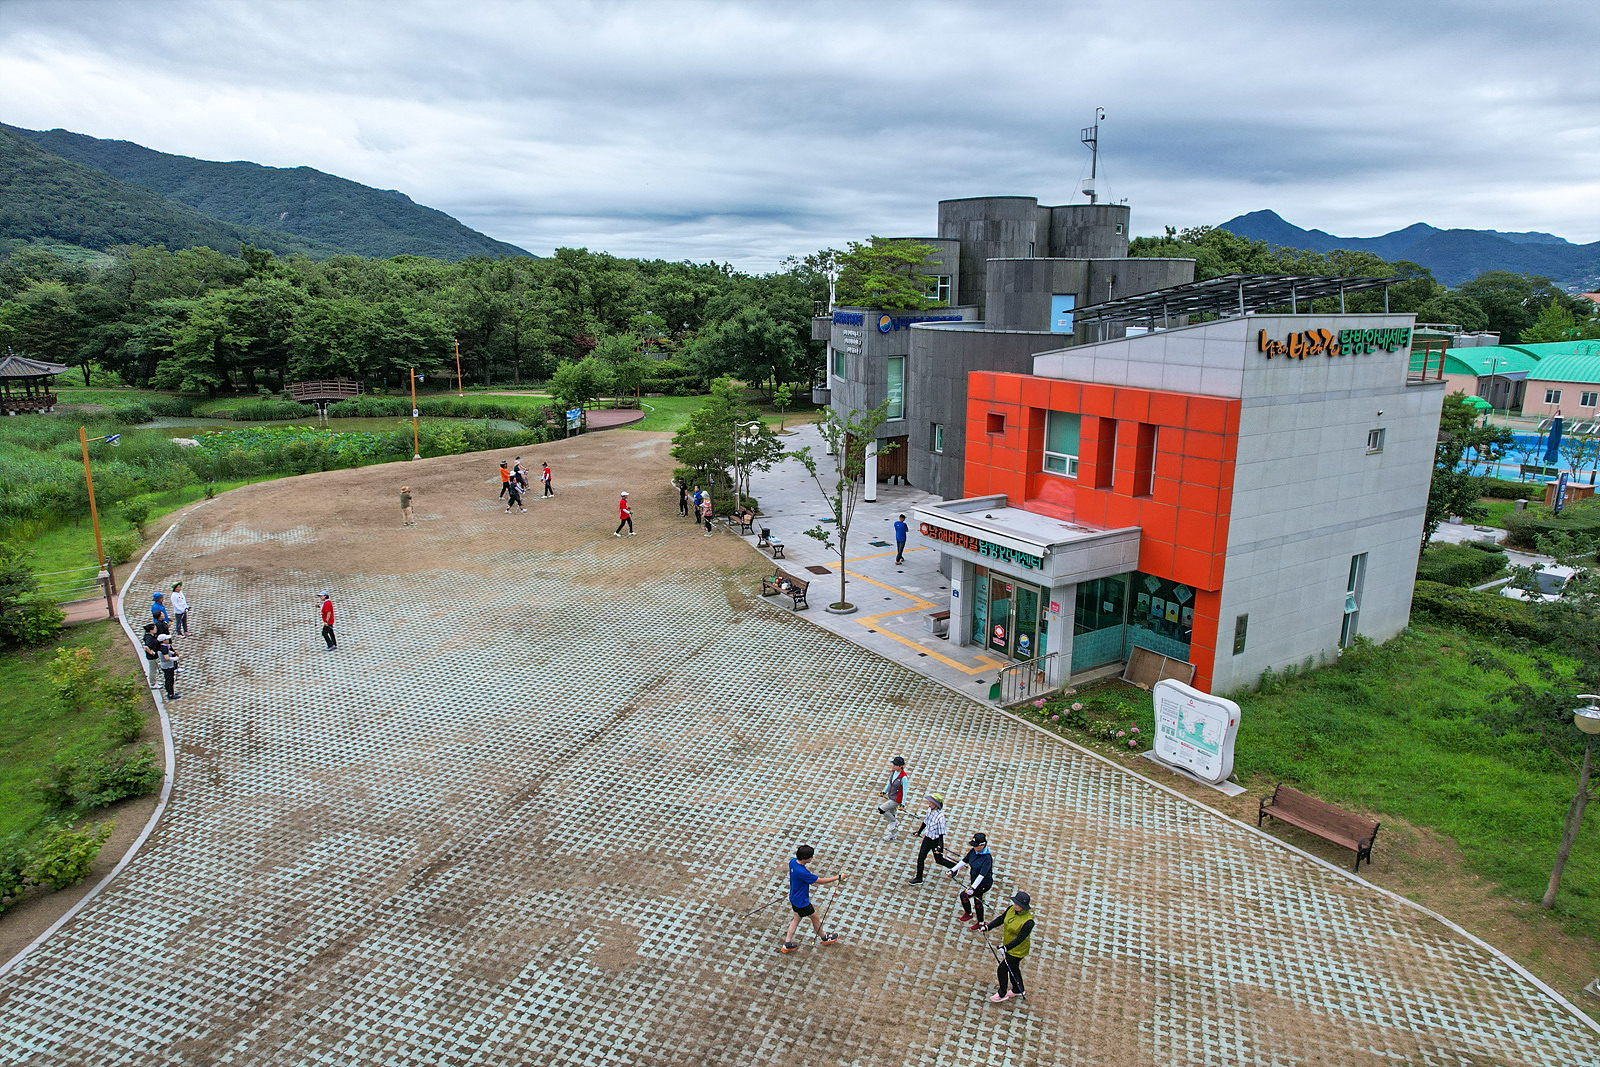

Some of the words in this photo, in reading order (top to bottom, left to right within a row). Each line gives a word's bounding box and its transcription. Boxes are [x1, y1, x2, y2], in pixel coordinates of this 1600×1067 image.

[1339, 328, 1411, 355] 탐방안내센터
[928, 524, 978, 552] 남해바래길
[978, 539, 1043, 570] 탐방안내센터
